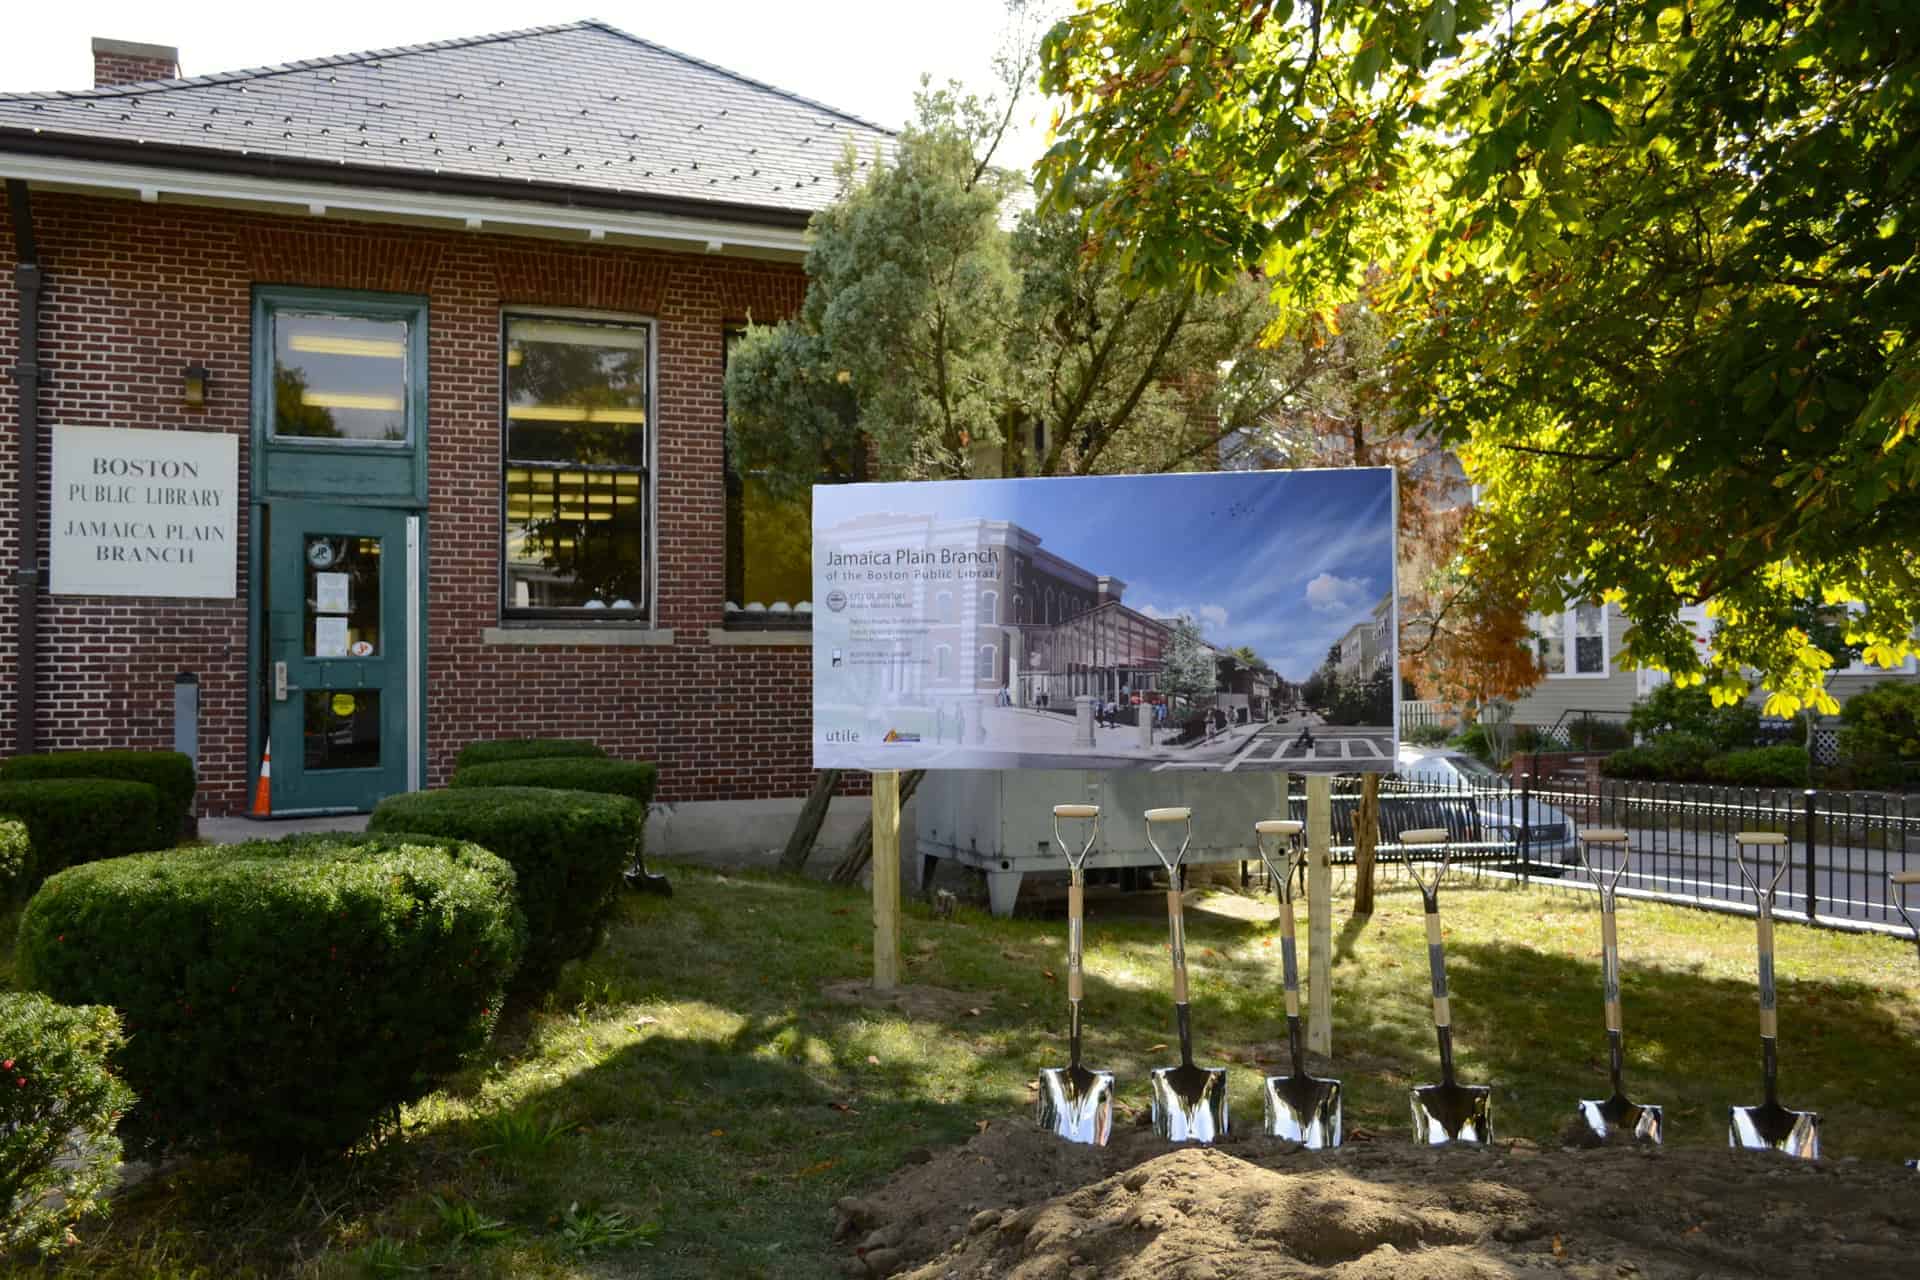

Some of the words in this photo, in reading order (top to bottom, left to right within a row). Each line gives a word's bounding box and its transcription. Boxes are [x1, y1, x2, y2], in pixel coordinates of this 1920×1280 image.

[92, 457, 198, 478] BOSTON
[69, 483, 136, 503] PUBLIC
[146, 487, 222, 507] LIBRARY
[64, 520, 156, 539] JAMAICA
[167, 524, 224, 541] PLAIN
[96, 545, 194, 563] BRANCH
[826, 551, 891, 566] Jamaica
[896, 549, 936, 565] Plain
[941, 548, 999, 564] Branch
[825, 570, 837, 581] of
[842, 570, 862, 581] the
[867, 569, 909, 580] Boston
[914, 568, 953, 580] Public
[958, 567, 1003, 580] Library
[826, 729, 860, 742] utile
